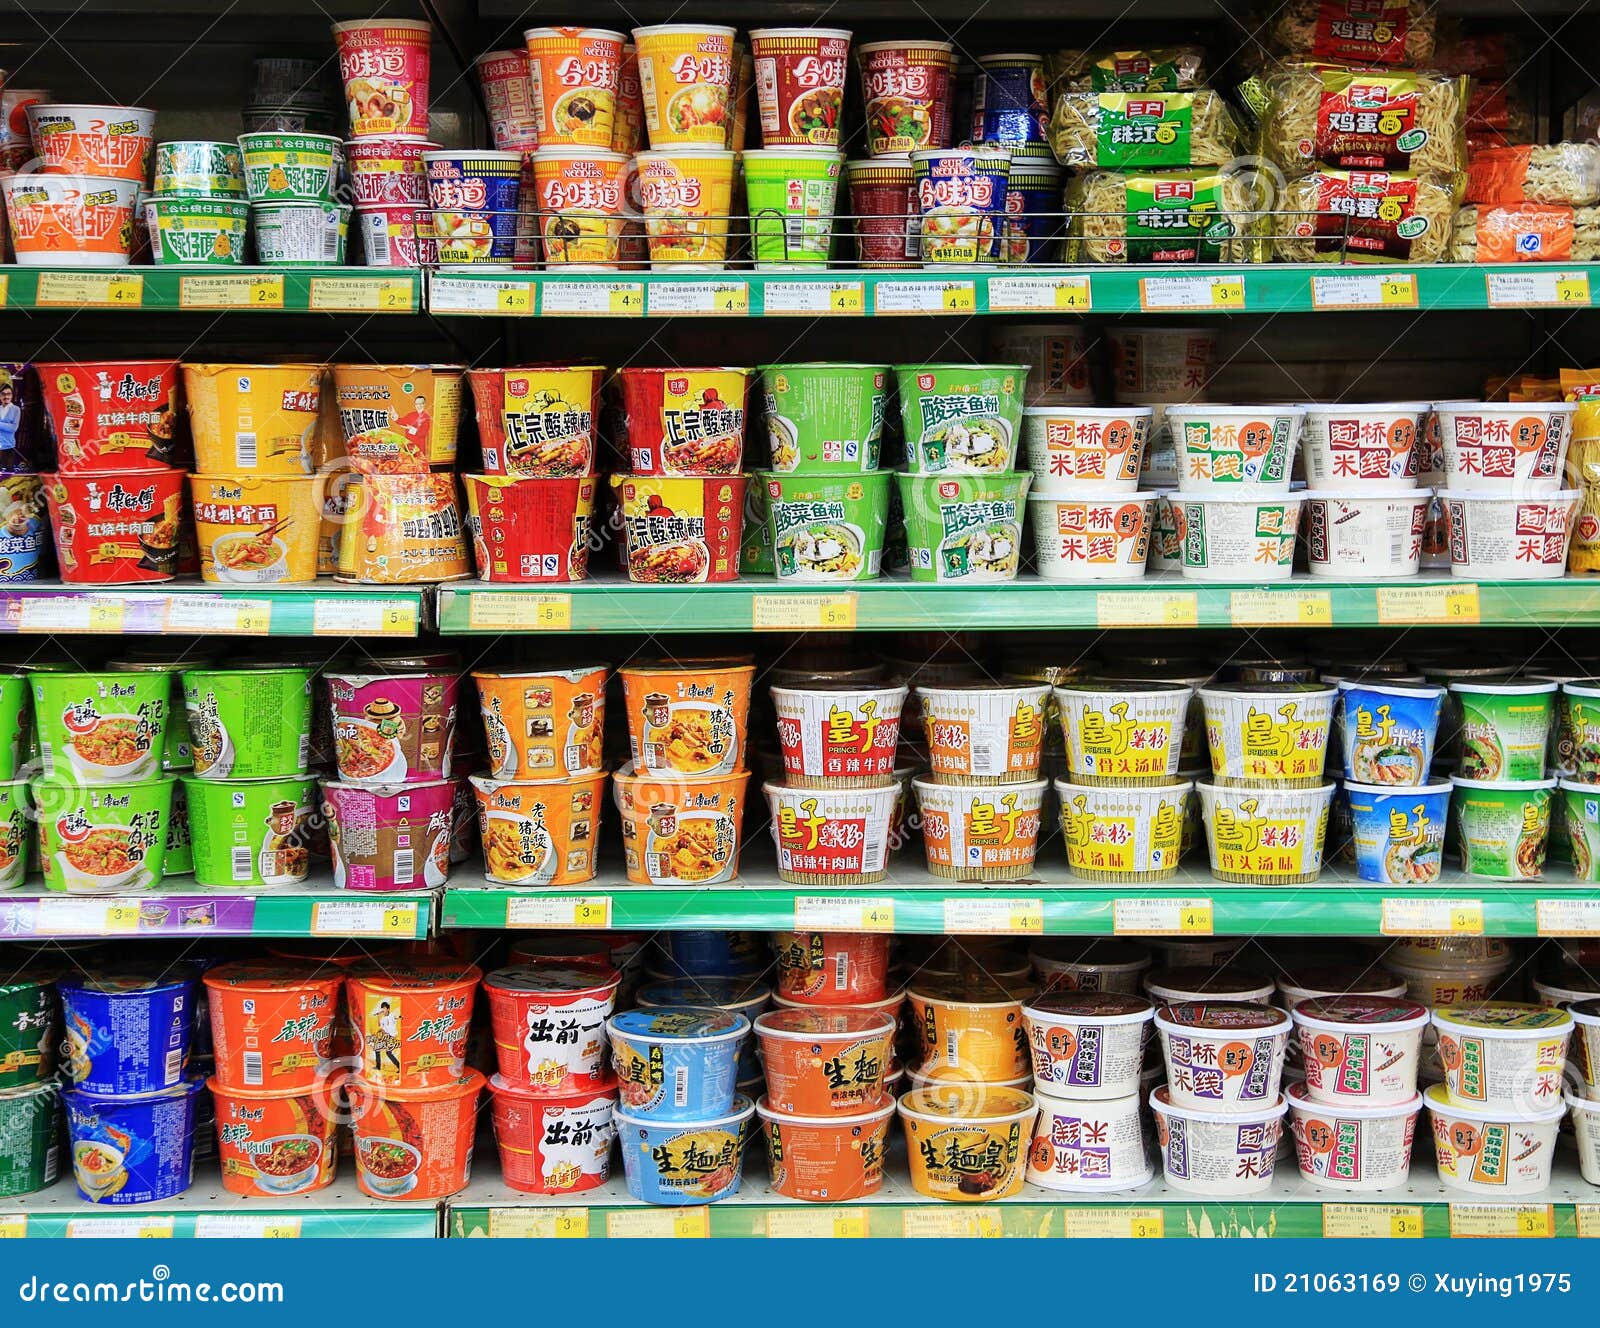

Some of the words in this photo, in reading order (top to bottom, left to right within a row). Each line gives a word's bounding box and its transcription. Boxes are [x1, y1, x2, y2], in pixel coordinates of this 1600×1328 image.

[593, 41, 612, 49] CUP
[706, 36, 724, 45] CUP
[1129, 103, 1162, 117] 三户
[433, 161, 452, 170] CUP
[564, 169, 603, 178] NOODLES
[572, 161, 595, 170] CUP
[932, 167, 971, 177] NOODLES
[939, 159, 963, 169] CUP
[429, 178, 487, 209] 味道
[543, 179, 620, 210] 合味道
[919, 177, 993, 207] 合味道
[1157, 184, 1191, 199] 三户
[97, 411, 161, 426] 红烧牛肉面
[920, 396, 999, 427] 酸菜鱼粉
[506, 411, 592, 451] 正宗酸辣粉
[1048, 421, 1102, 449] 过桥
[1187, 424, 1238, 450] 过桥
[1331, 420, 1387, 448] 过桥
[1457, 417, 1511, 446] 过桥
[1050, 453, 1105, 478] 米线
[1190, 455, 1242, 480] 米线
[1332, 451, 1390, 477] 米线
[1458, 451, 1515, 477] 米线
[88, 522, 155, 537] 红烧牛肉面
[774, 502, 845, 534] 酸菜鱼粉
[942, 502, 1017, 533] 酸菜鱼粉
[1060, 507, 1114, 534] 过桥
[1519, 507, 1566, 533] 过桥
[625, 515, 705, 552] 正宗酸辣粉
[1060, 537, 1116, 562] 米线
[1516, 537, 1564, 564] 米线
[135, 703, 151, 751] 牛肉面
[828, 700, 882, 755] 皇子
[1083, 701, 1137, 756] 皇子
[1130, 725, 1168, 750] 薯粉
[1247, 702, 1304, 758] 皇子
[1356, 705, 1396, 747] 皇子
[1392, 729, 1426, 747] 米线
[829, 746, 858, 754] PRINCE
[1098, 756, 1165, 774] 骨头汤味
[1252, 759, 1320, 776] 骨头汤味
[780, 798, 827, 851] 皇子
[969, 793, 1023, 845] 皇子
[1215, 799, 1268, 852] 皇子
[1389, 804, 1431, 847] 皇子
[127, 814, 144, 862] 牛肉面
[519, 821, 537, 865] 猪骨面
[970, 838, 999, 846] PRINCE
[1090, 822, 1132, 844] 薯粉
[1260, 825, 1299, 848] 薯粉
[792, 854, 859, 870] 香辣牛肉味
[1222, 854, 1294, 872] 骨头汤味
[530, 1016, 612, 1044] 出前一
[1171, 1036, 1217, 1066] 过桥
[530, 1065, 569, 1086] 鸡蛋面
[1174, 1069, 1223, 1095] 米线
[545, 1166, 582, 1188] 鸡蛋面
